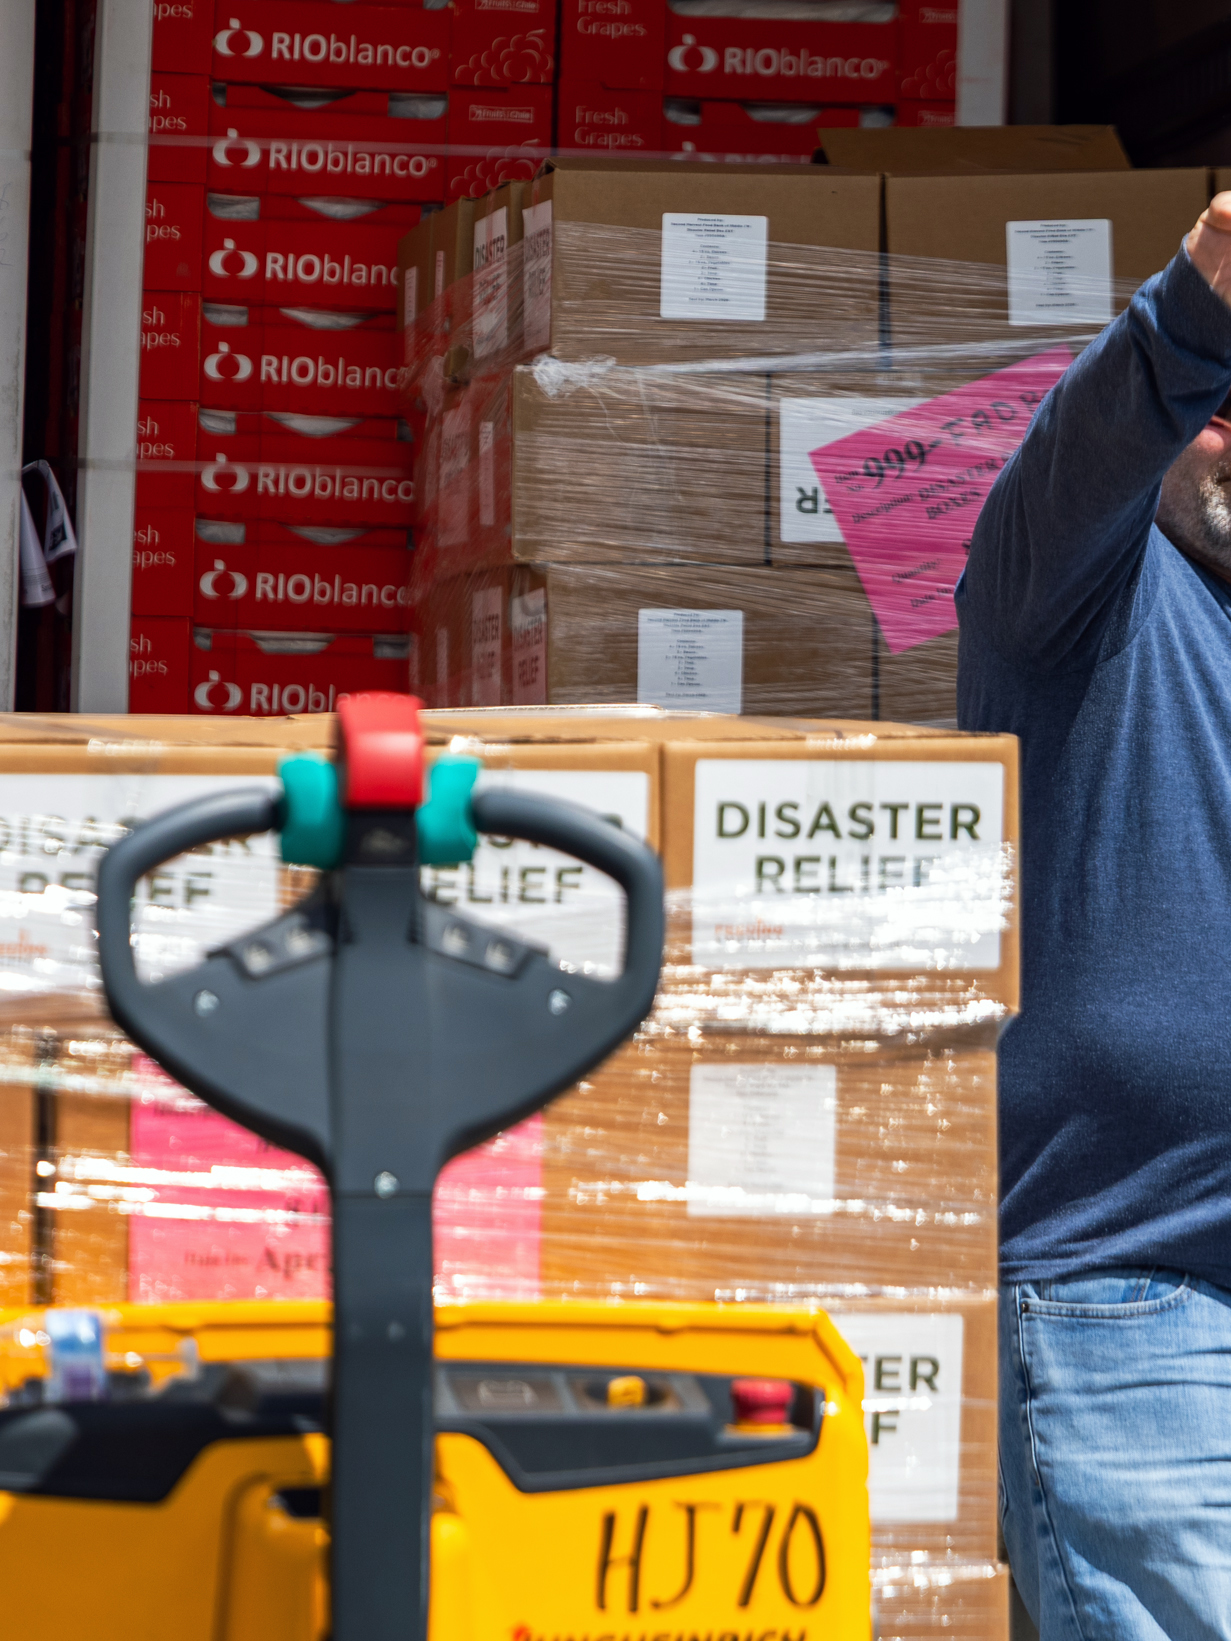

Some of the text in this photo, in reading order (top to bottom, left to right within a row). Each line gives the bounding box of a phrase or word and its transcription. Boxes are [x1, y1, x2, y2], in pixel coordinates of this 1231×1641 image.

[576, 16, 648, 39] Grapes
[575, 105, 630, 125] Fresh
[574, 126, 646, 150] Grapes
[265, 252, 399, 286] RIOblanc
[715, 800, 982, 842] DISASTER
[430, 864, 583, 905] ELIEF
[754, 854, 943, 894] RELIEF
